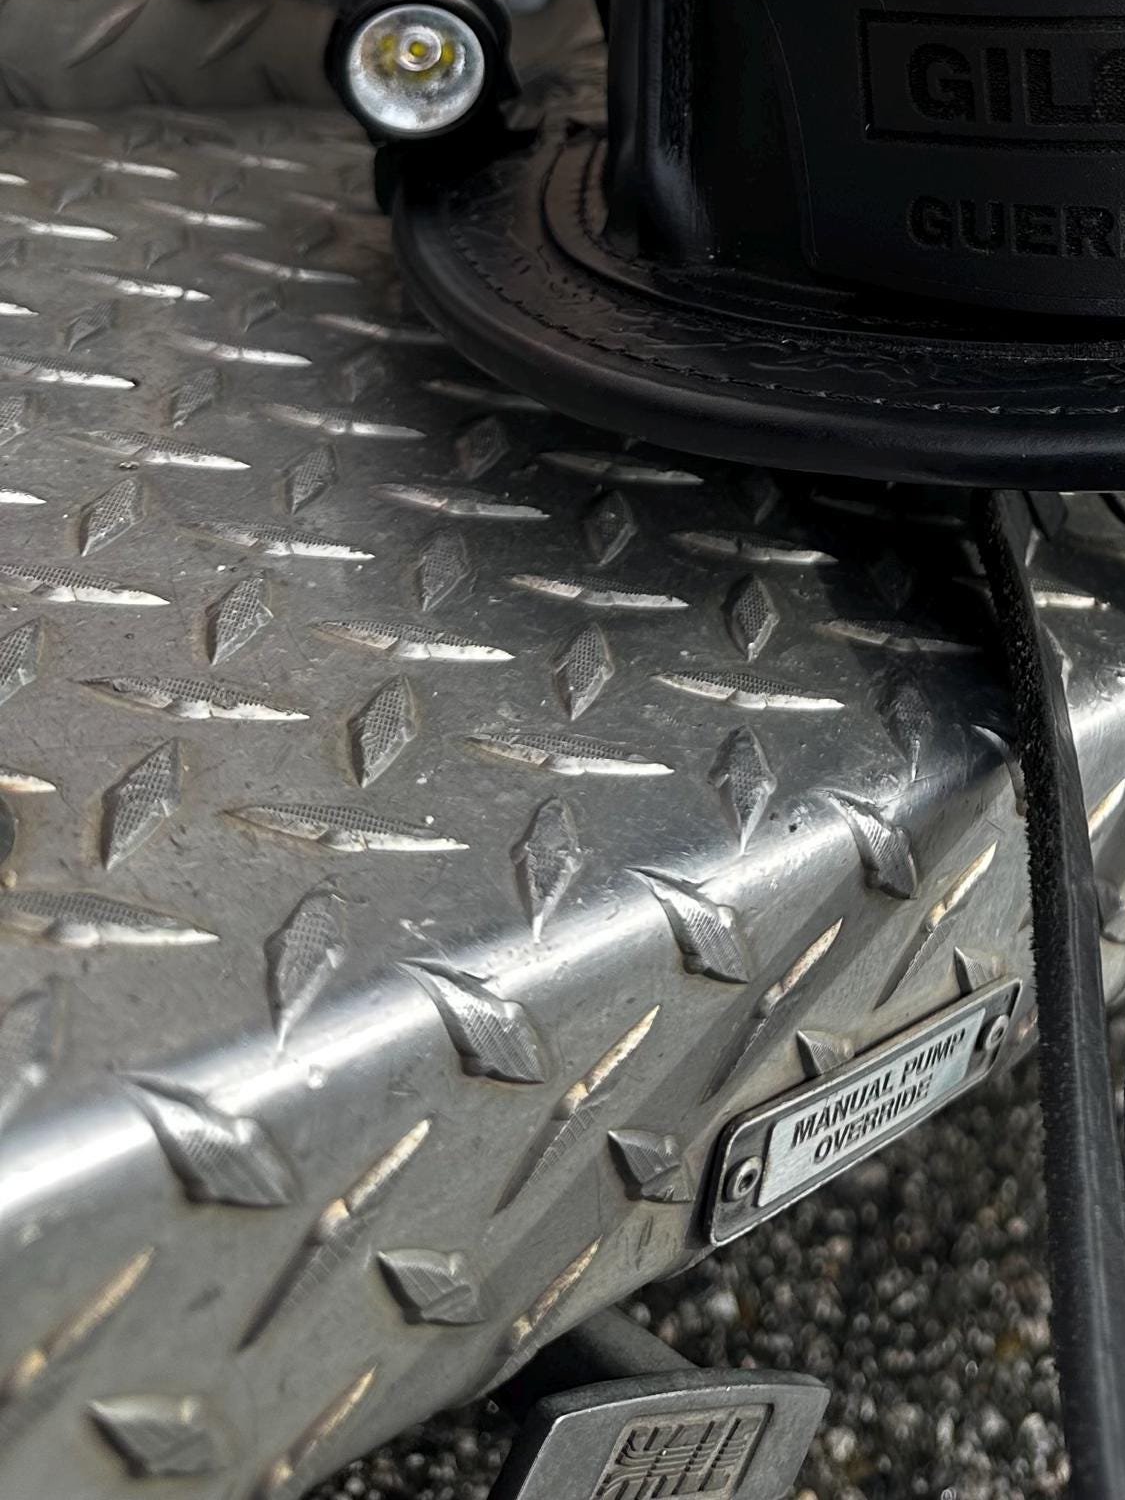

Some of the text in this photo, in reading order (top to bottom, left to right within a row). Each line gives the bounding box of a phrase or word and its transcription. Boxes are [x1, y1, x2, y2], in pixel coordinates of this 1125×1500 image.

[791, 1028, 966, 1149] MANUAL PUMP
[813, 1074, 933, 1164] OVERRIDE
